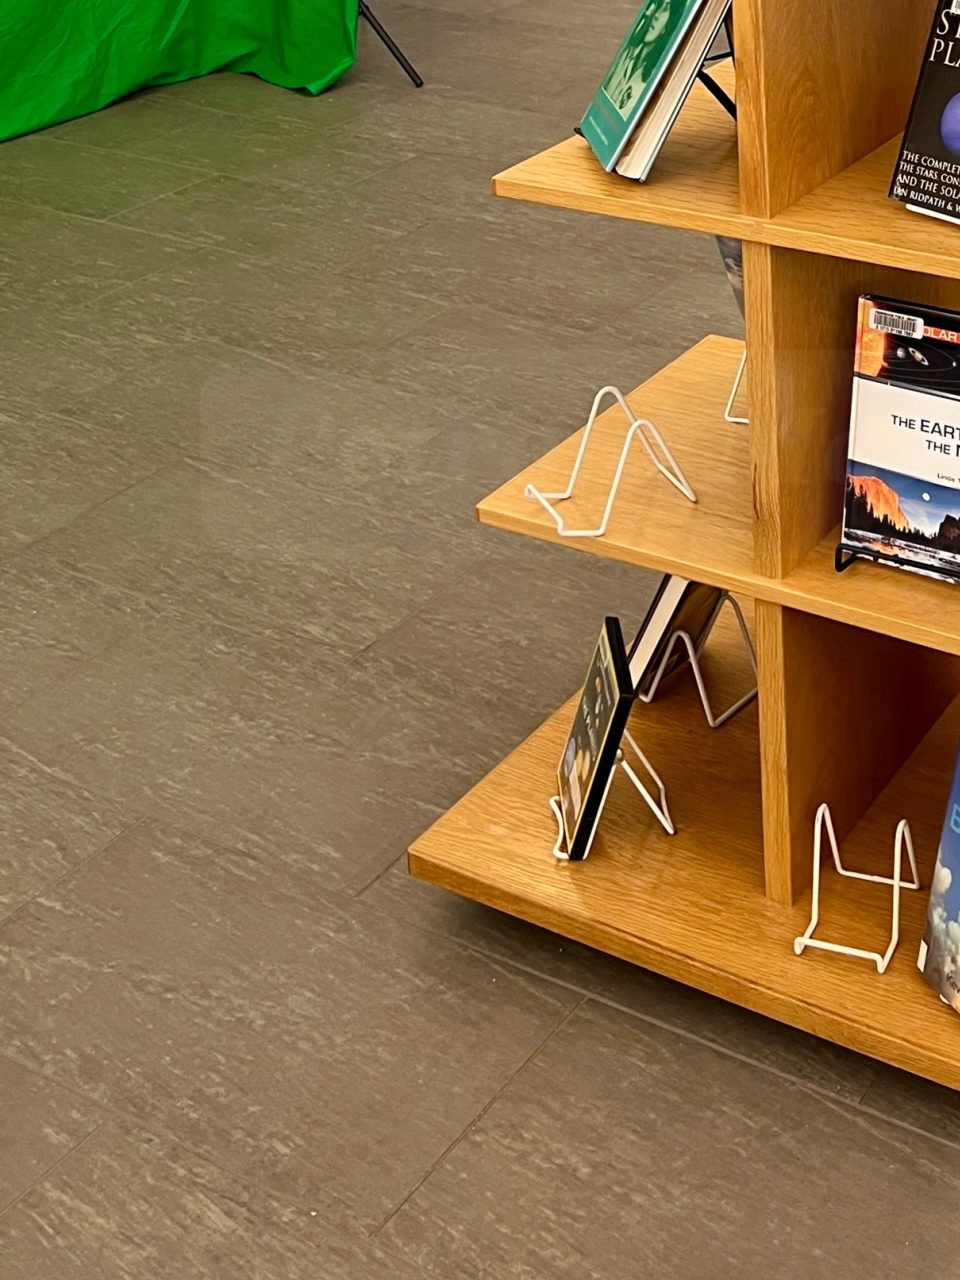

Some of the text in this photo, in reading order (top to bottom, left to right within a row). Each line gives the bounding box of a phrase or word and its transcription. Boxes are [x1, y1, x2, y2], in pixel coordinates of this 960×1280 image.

[902, 150, 920, 164] THE
[900, 161, 914, 174] THE
[896, 173, 918, 188] AND
[919, 179, 938, 193] THE
[909, 190, 945, 209] RIDPATH
[946, 201, 953, 211] &
[923, 325, 958, 344] OLAR
[891, 415, 916, 430] THE
[925, 439, 951, 456] THE
[937, 472, 955, 483] Linda
